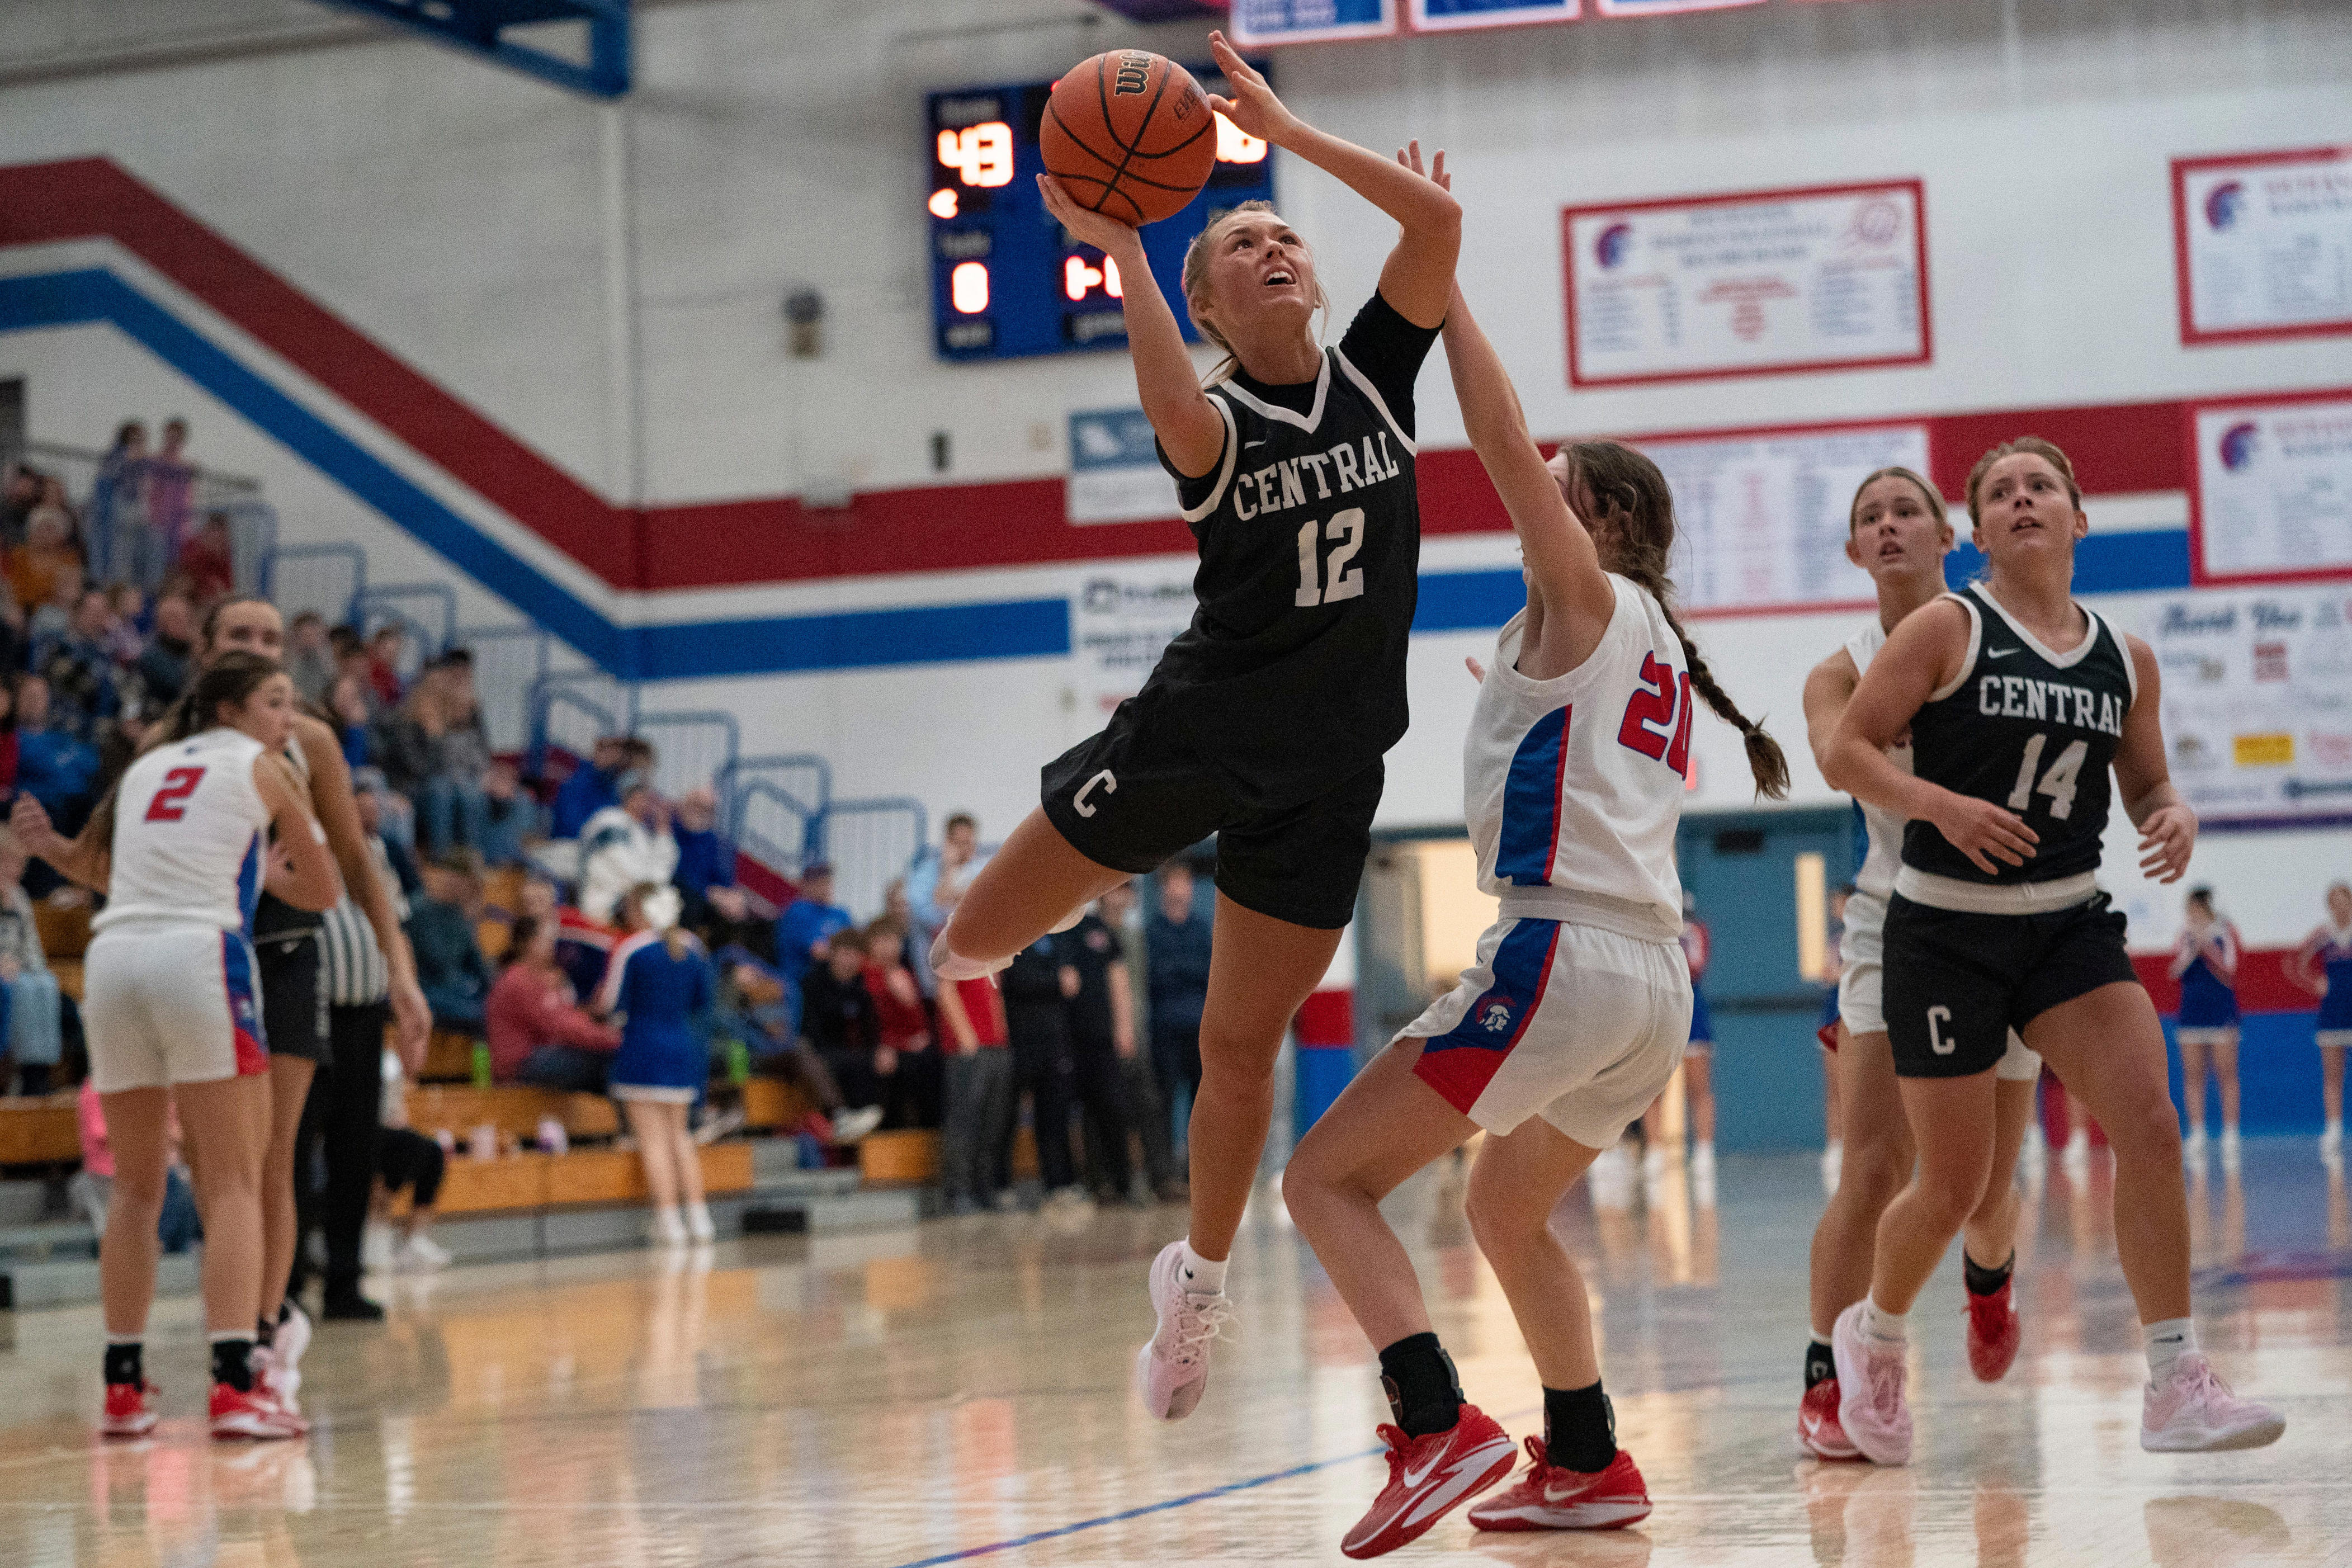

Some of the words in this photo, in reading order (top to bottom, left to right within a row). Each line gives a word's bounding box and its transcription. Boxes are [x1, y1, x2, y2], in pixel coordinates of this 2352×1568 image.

[1234, 431, 1399, 521] CENTRAL
[1295, 508, 1364, 607] 12
[144, 766, 207, 823] 2
[1073, 769, 1117, 818] C
[2008, 733, 2088, 820] 14
[1927, 1005, 1955, 1055] C
